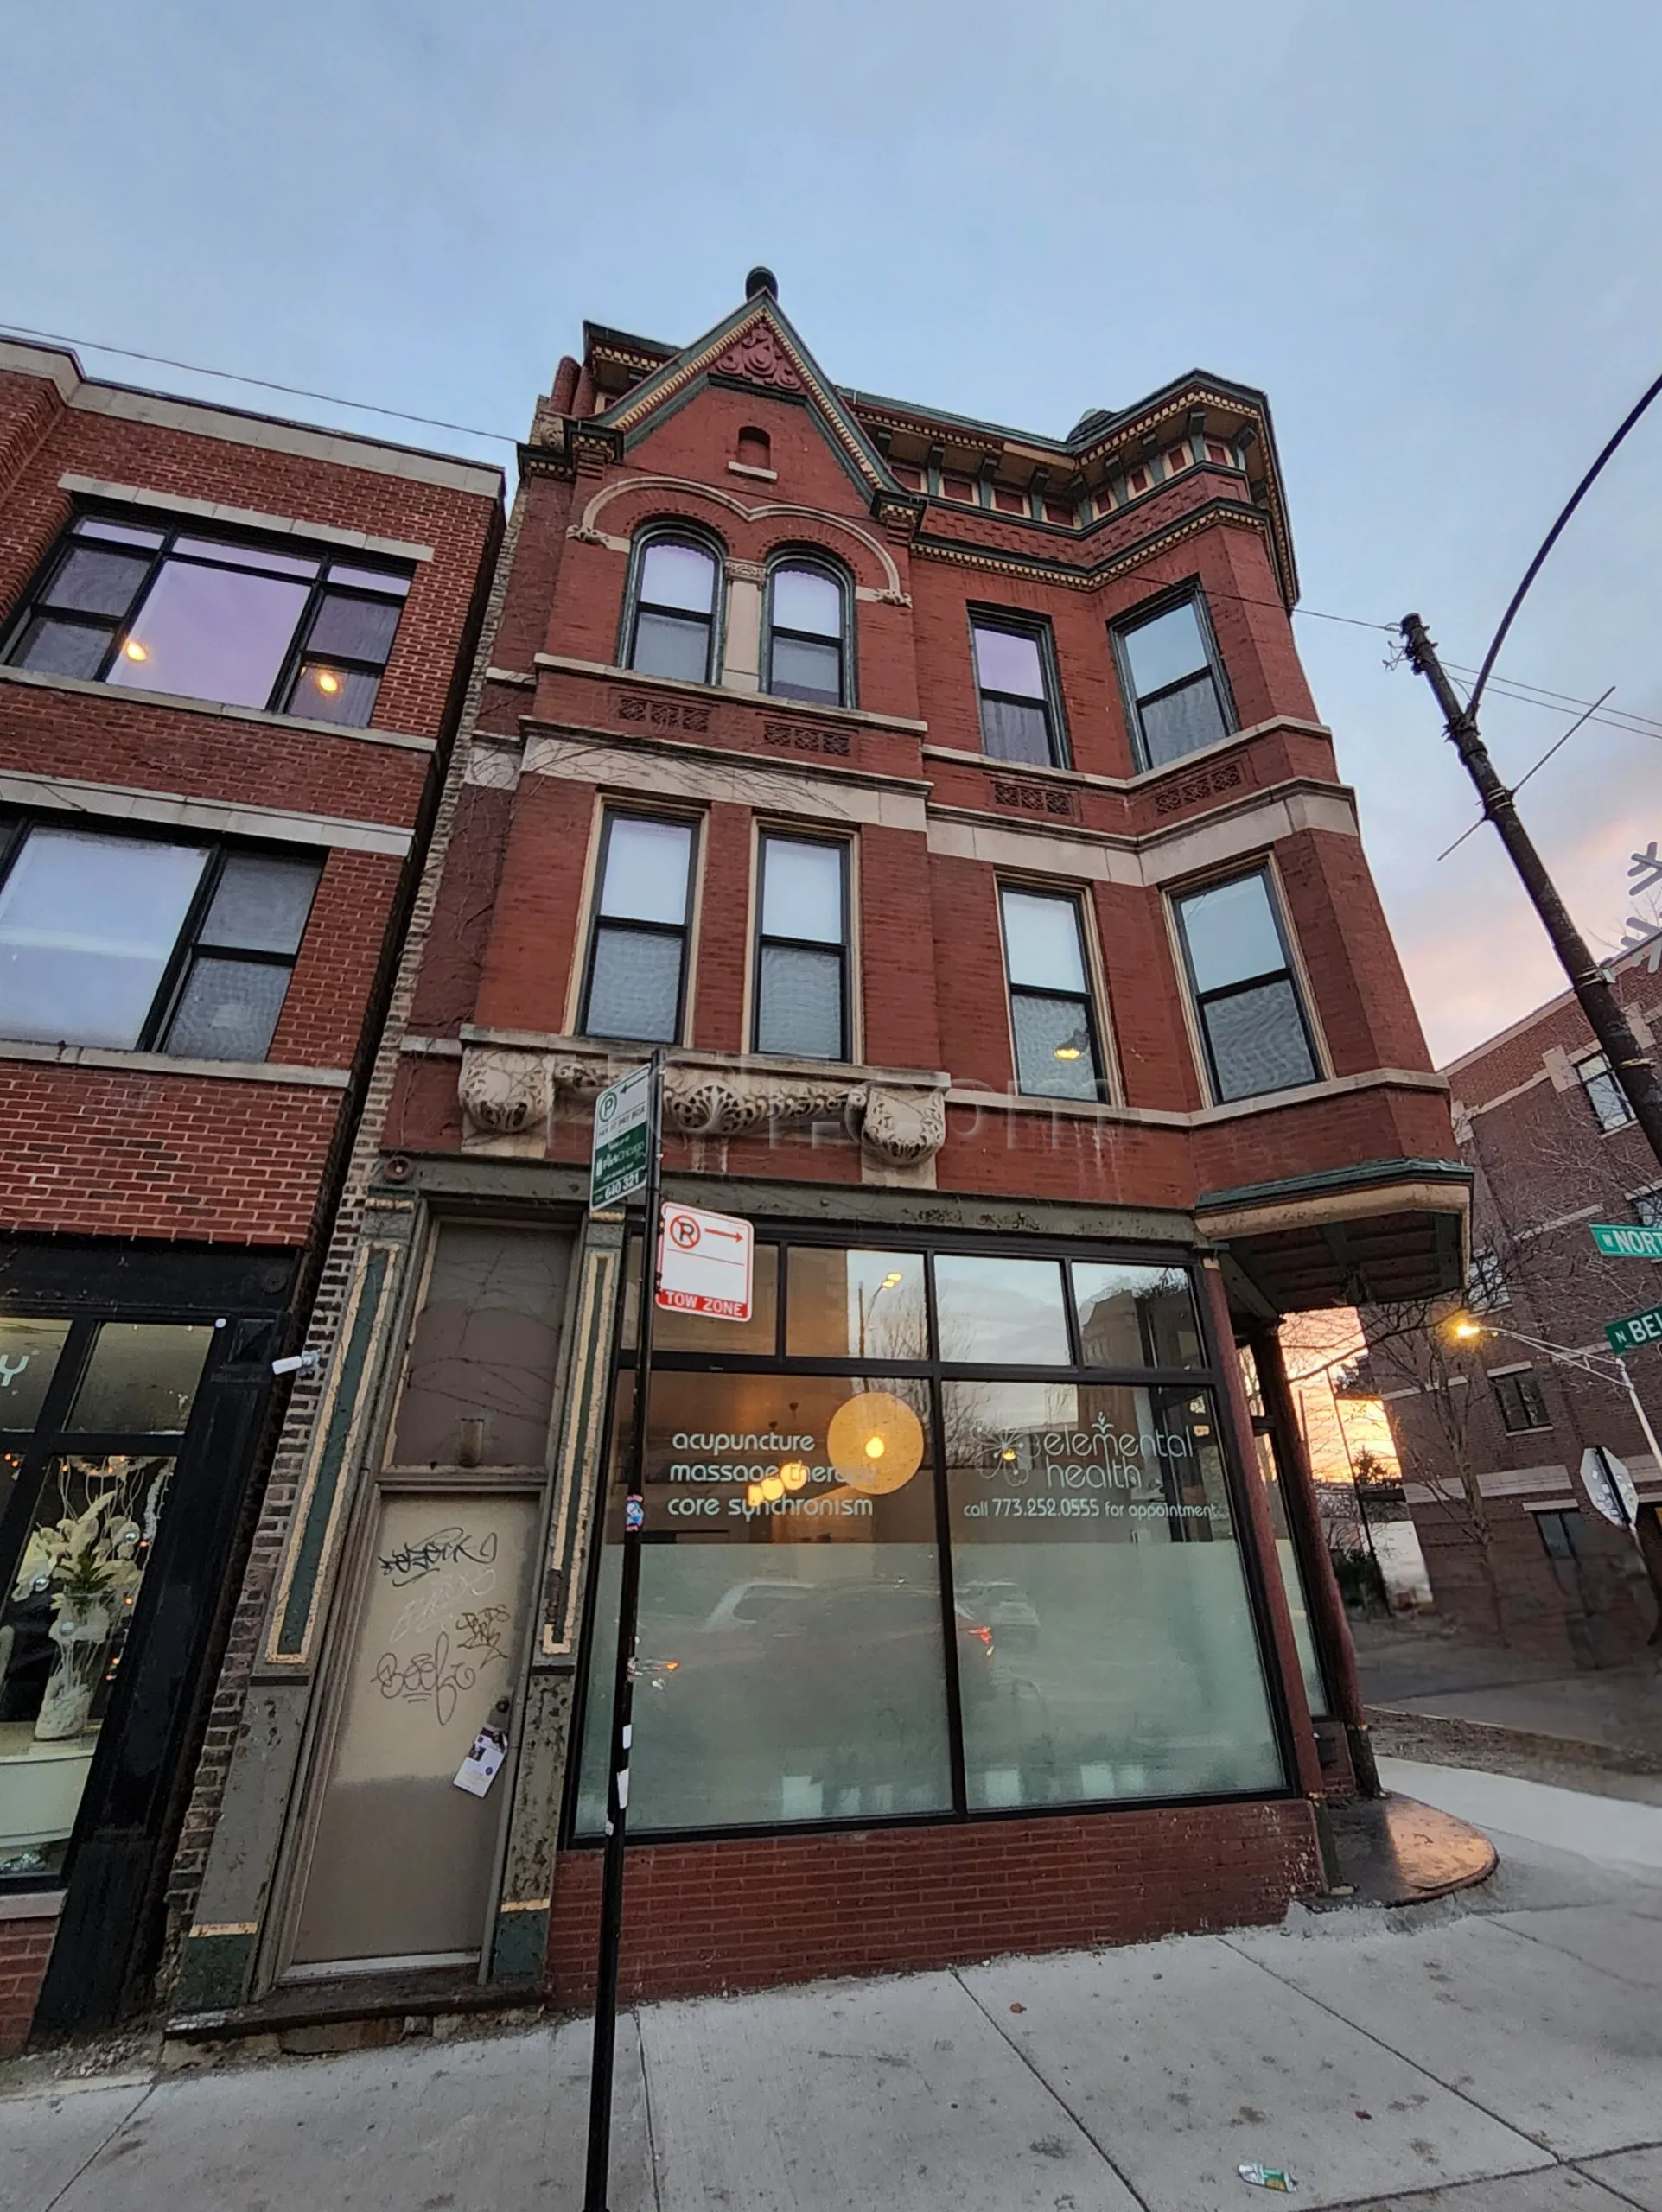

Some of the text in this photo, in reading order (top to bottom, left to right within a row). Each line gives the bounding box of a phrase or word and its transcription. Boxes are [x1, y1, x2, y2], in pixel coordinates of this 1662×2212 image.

[1602, 1234, 1614, 1248] W
[665, 1290, 743, 1317] TOW ZONE
[1614, 1329, 1627, 1344] N
[672, 1431, 815, 1457] acupuncture
[1043, 1424, 1194, 1458] elemental
[1045, 1455, 1143, 1489] health
[667, 1494, 874, 1522] core synchronism
[963, 1500, 989, 1517] call
[991, 1497, 1100, 1517] 773.252.0555
[1105, 1500, 1124, 1517] for
